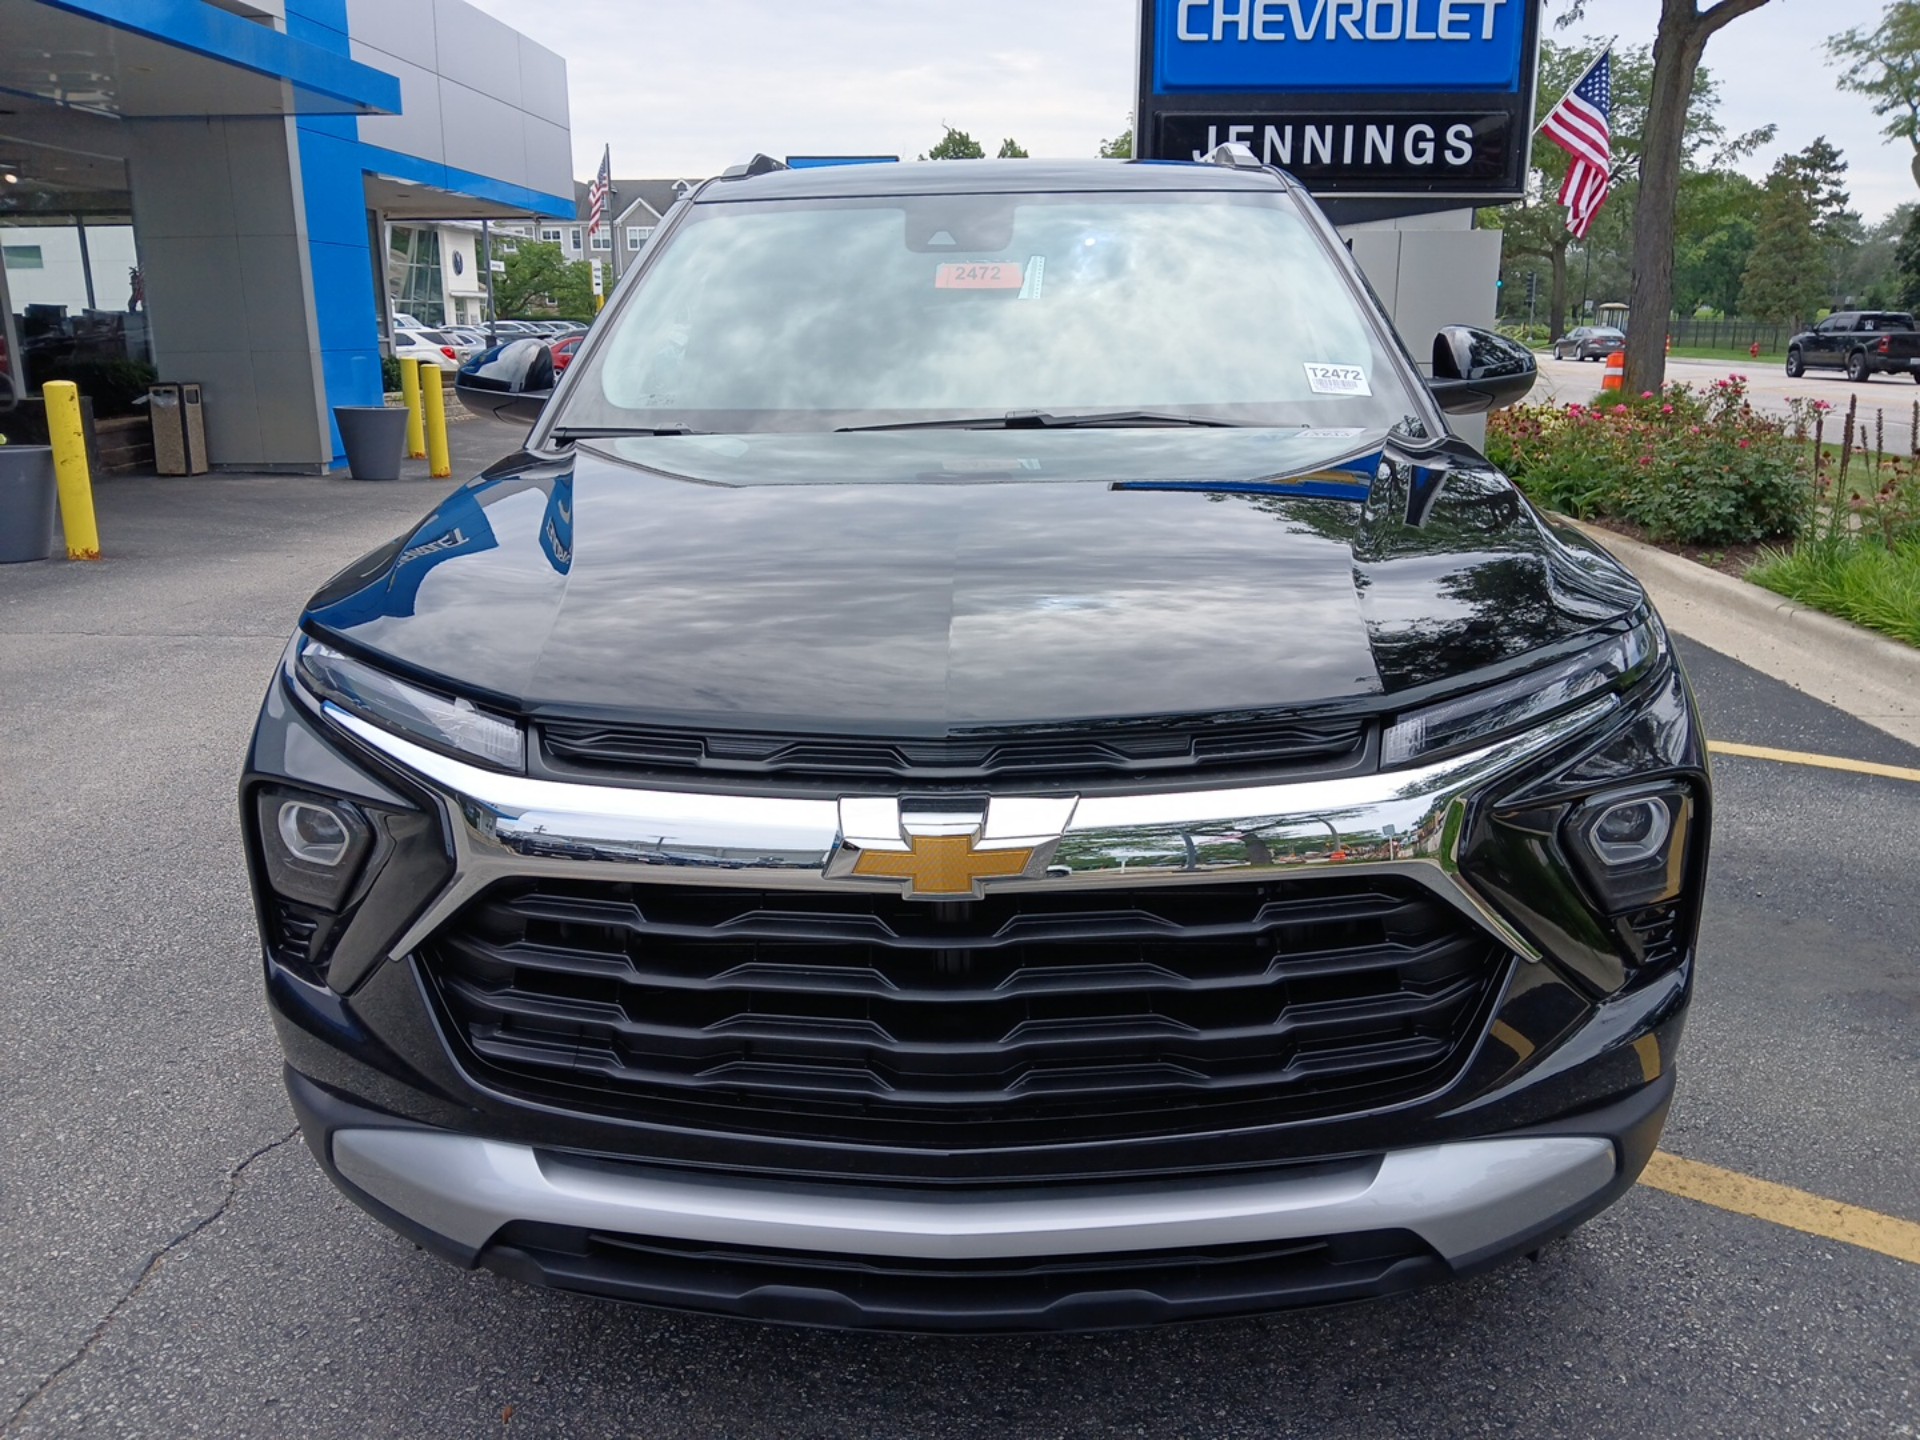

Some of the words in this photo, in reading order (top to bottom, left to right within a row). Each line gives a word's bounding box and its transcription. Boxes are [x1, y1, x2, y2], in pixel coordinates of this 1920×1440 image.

[1177, 0, 1506, 41] CHEVROLET
[955, 265, 1001, 281] 2472
[1308, 367, 1363, 381] T2472
